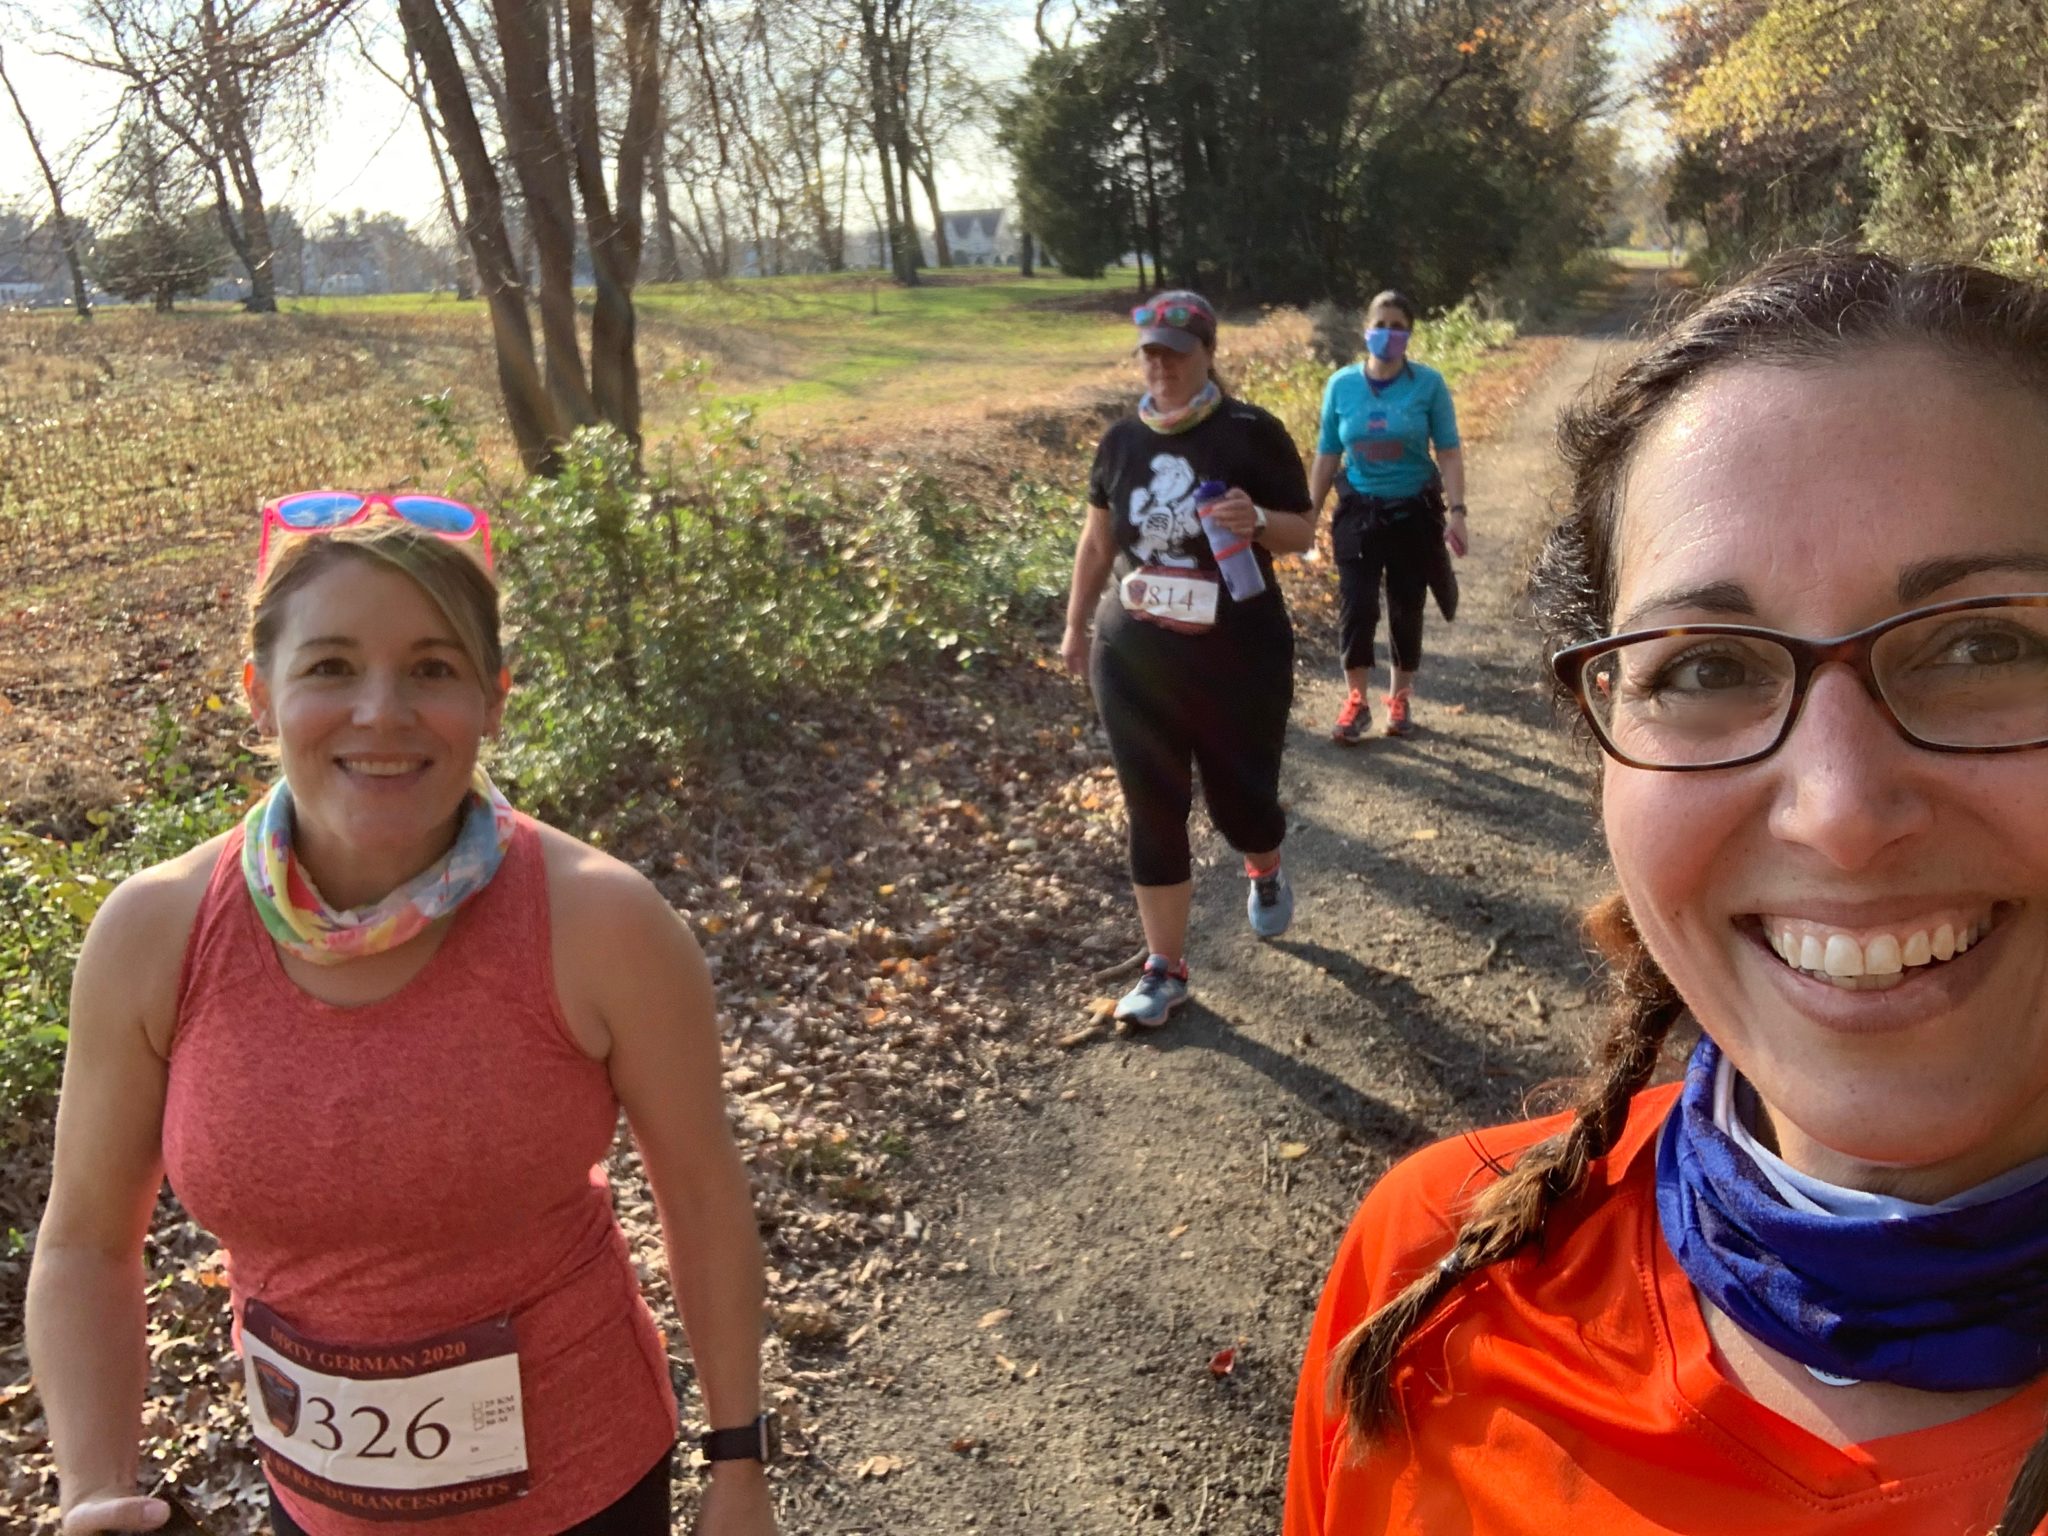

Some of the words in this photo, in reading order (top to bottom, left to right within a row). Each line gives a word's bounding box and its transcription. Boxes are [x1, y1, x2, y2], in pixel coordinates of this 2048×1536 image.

[319, 1352, 416, 1372] GERMAN
[422, 1340, 467, 1365] 2020
[306, 1396, 451, 1460] 326
